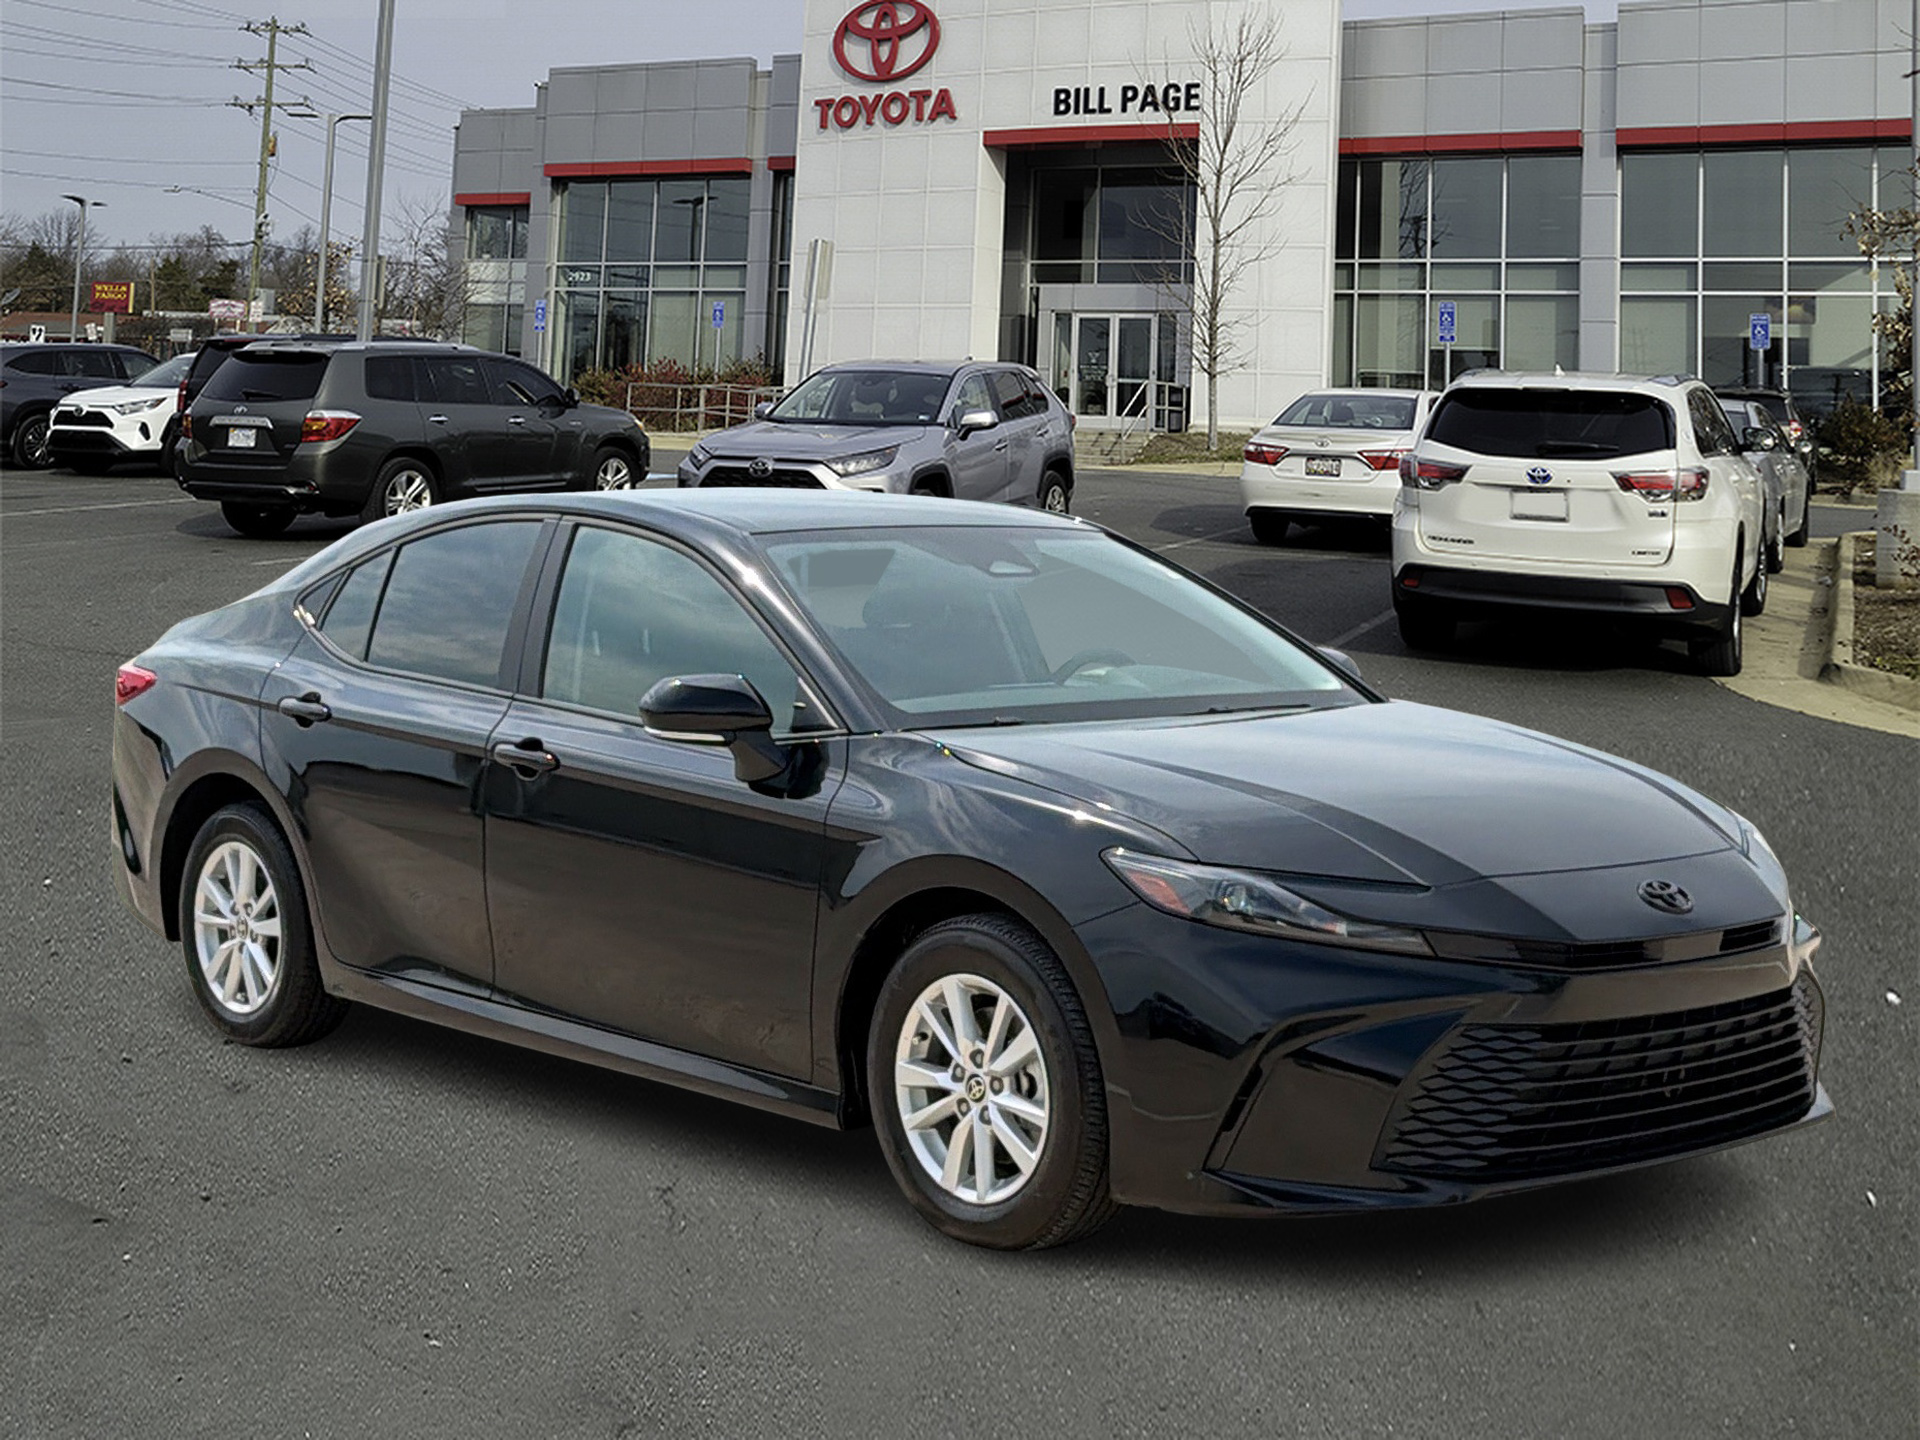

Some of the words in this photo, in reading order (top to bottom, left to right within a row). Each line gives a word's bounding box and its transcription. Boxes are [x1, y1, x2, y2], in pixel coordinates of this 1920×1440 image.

[814, 88, 957, 129] TOYOTA
[1053, 86, 1112, 116] BILL
[1121, 82, 1201, 113] PAGE
[568, 271, 591, 281] 2923
